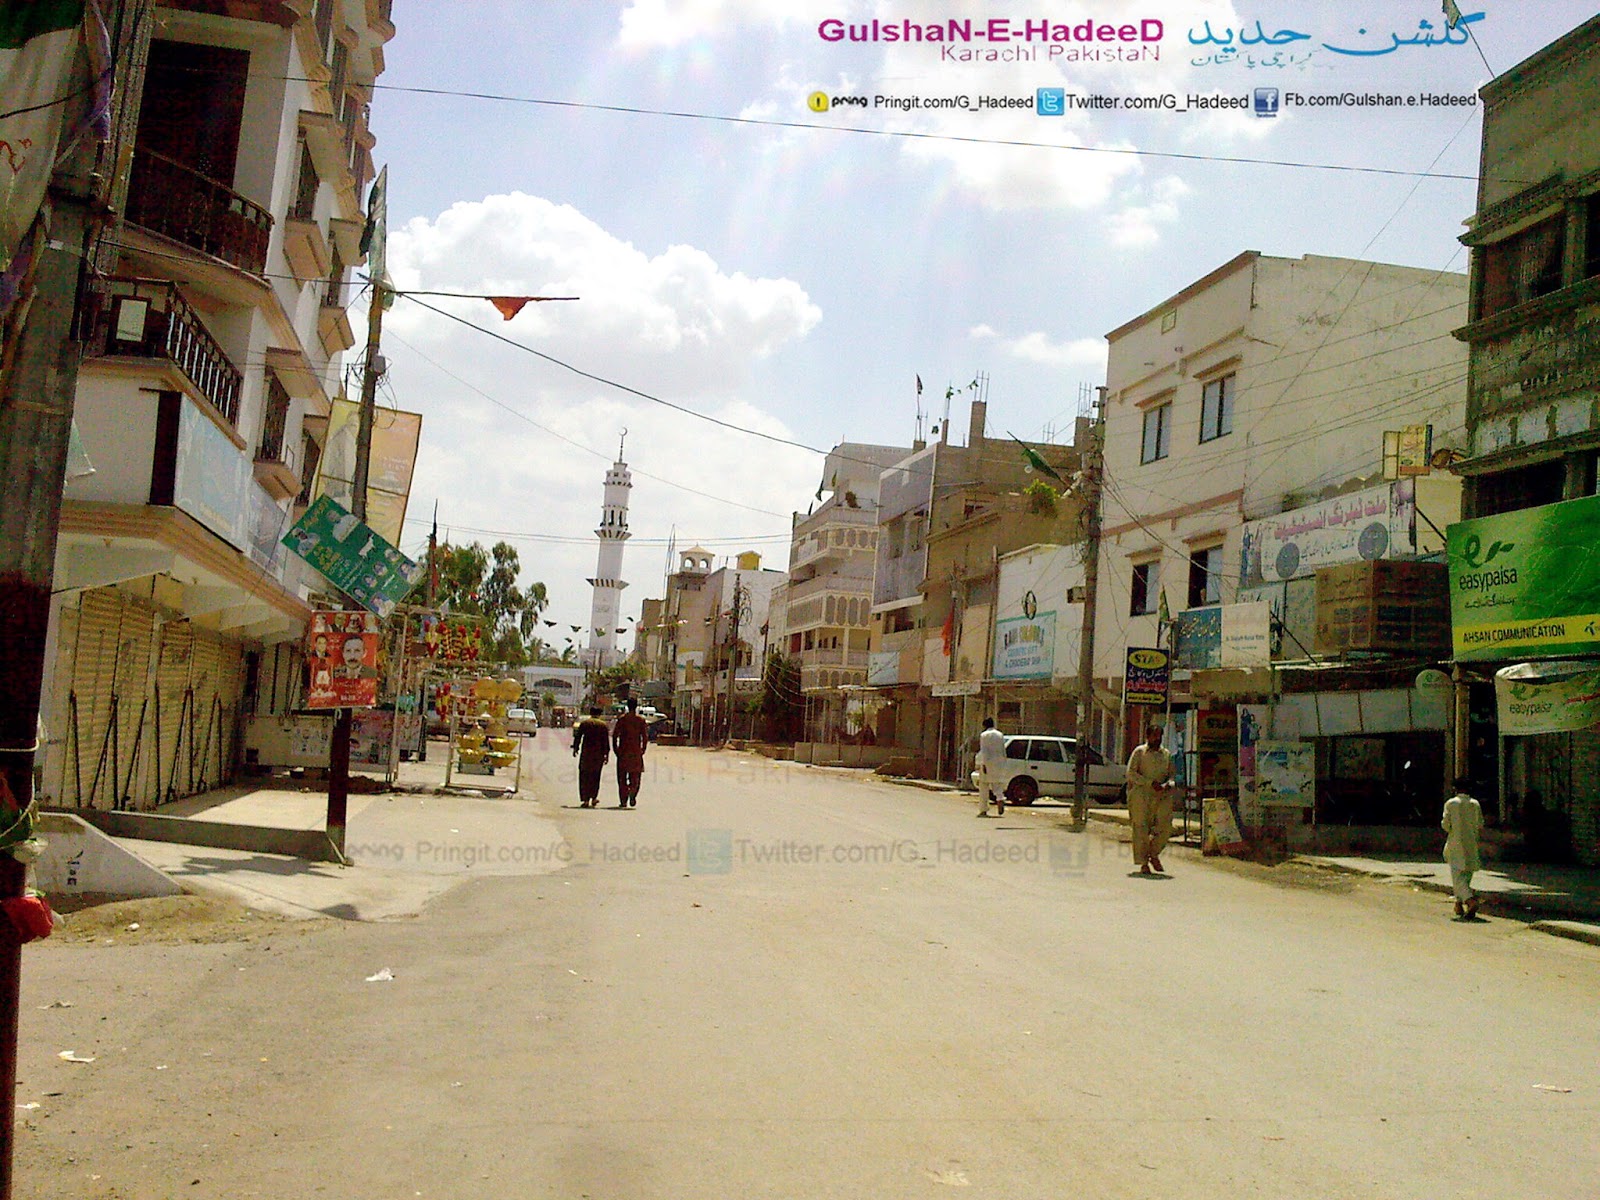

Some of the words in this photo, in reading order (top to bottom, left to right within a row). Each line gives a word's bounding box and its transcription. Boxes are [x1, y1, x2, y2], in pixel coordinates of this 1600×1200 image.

[1459, 566, 1518, 592] easypaisa
[1463, 630, 1491, 644] AHSAN
[1492, 623, 1566, 642] COMMUNICATION
